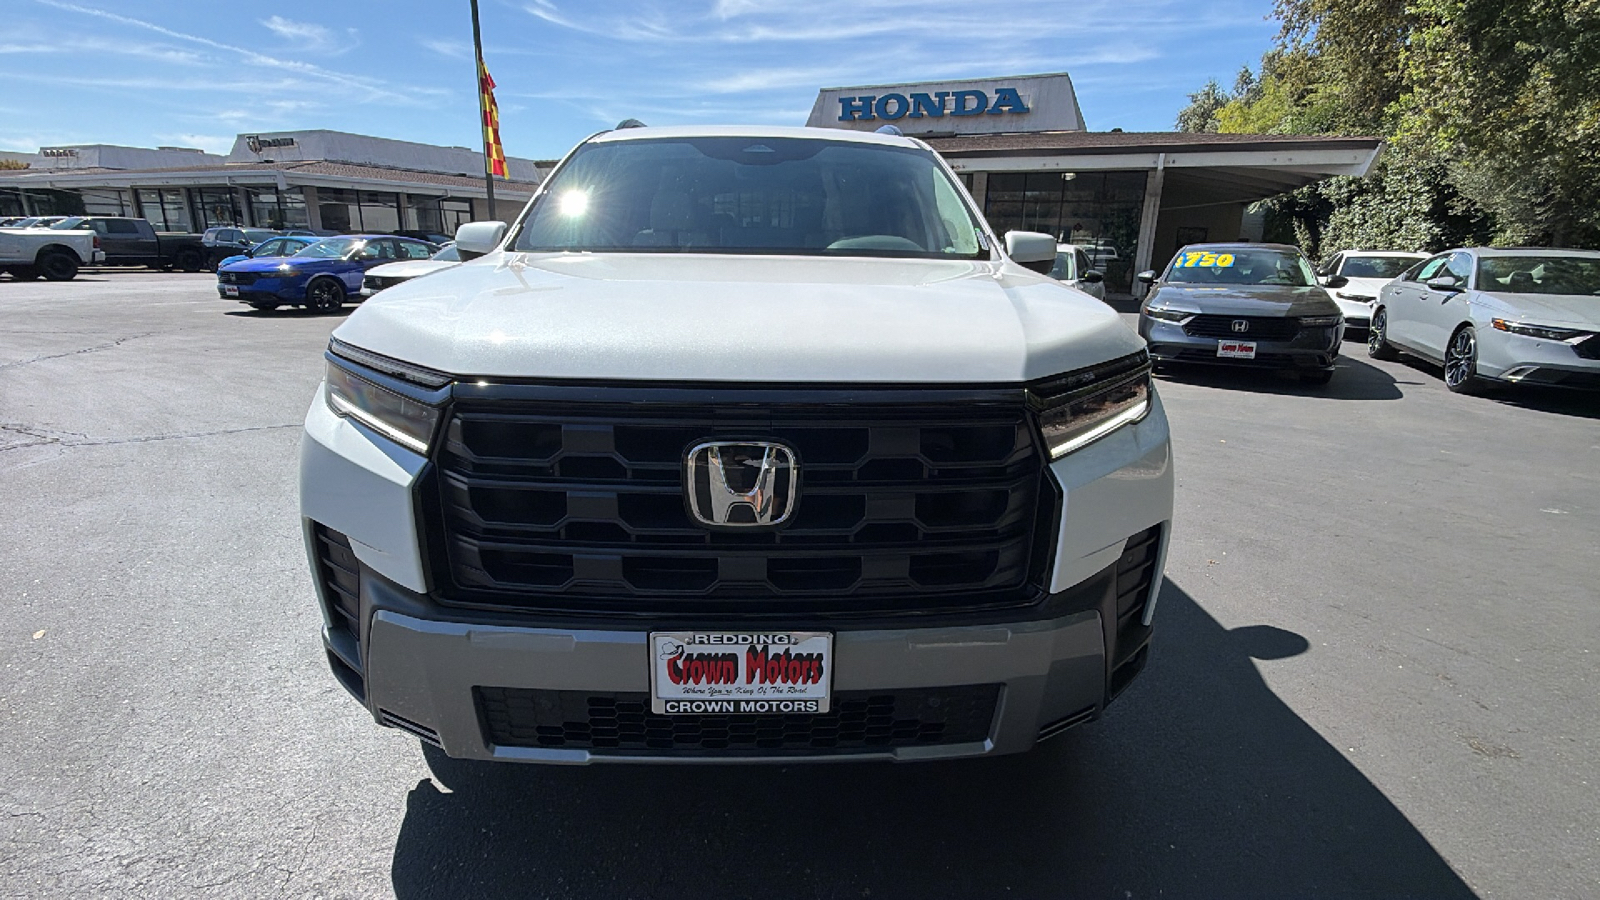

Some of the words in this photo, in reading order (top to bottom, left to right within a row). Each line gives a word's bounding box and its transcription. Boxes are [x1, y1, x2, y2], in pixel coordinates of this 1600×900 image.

[838, 88, 1030, 121] HONDA
[694, 634, 789, 644] REDDING
[667, 646, 739, 685] Crown
[746, 645, 823, 685] Motors
[682, 686, 705, 694] Where
[735, 686, 754, 695] King
[757, 686, 767, 694] Of
[770, 686, 784, 694] The
[786, 686, 808, 694] Road
[666, 701, 734, 712] CROWN
[740, 701, 818, 712] MOTORS
